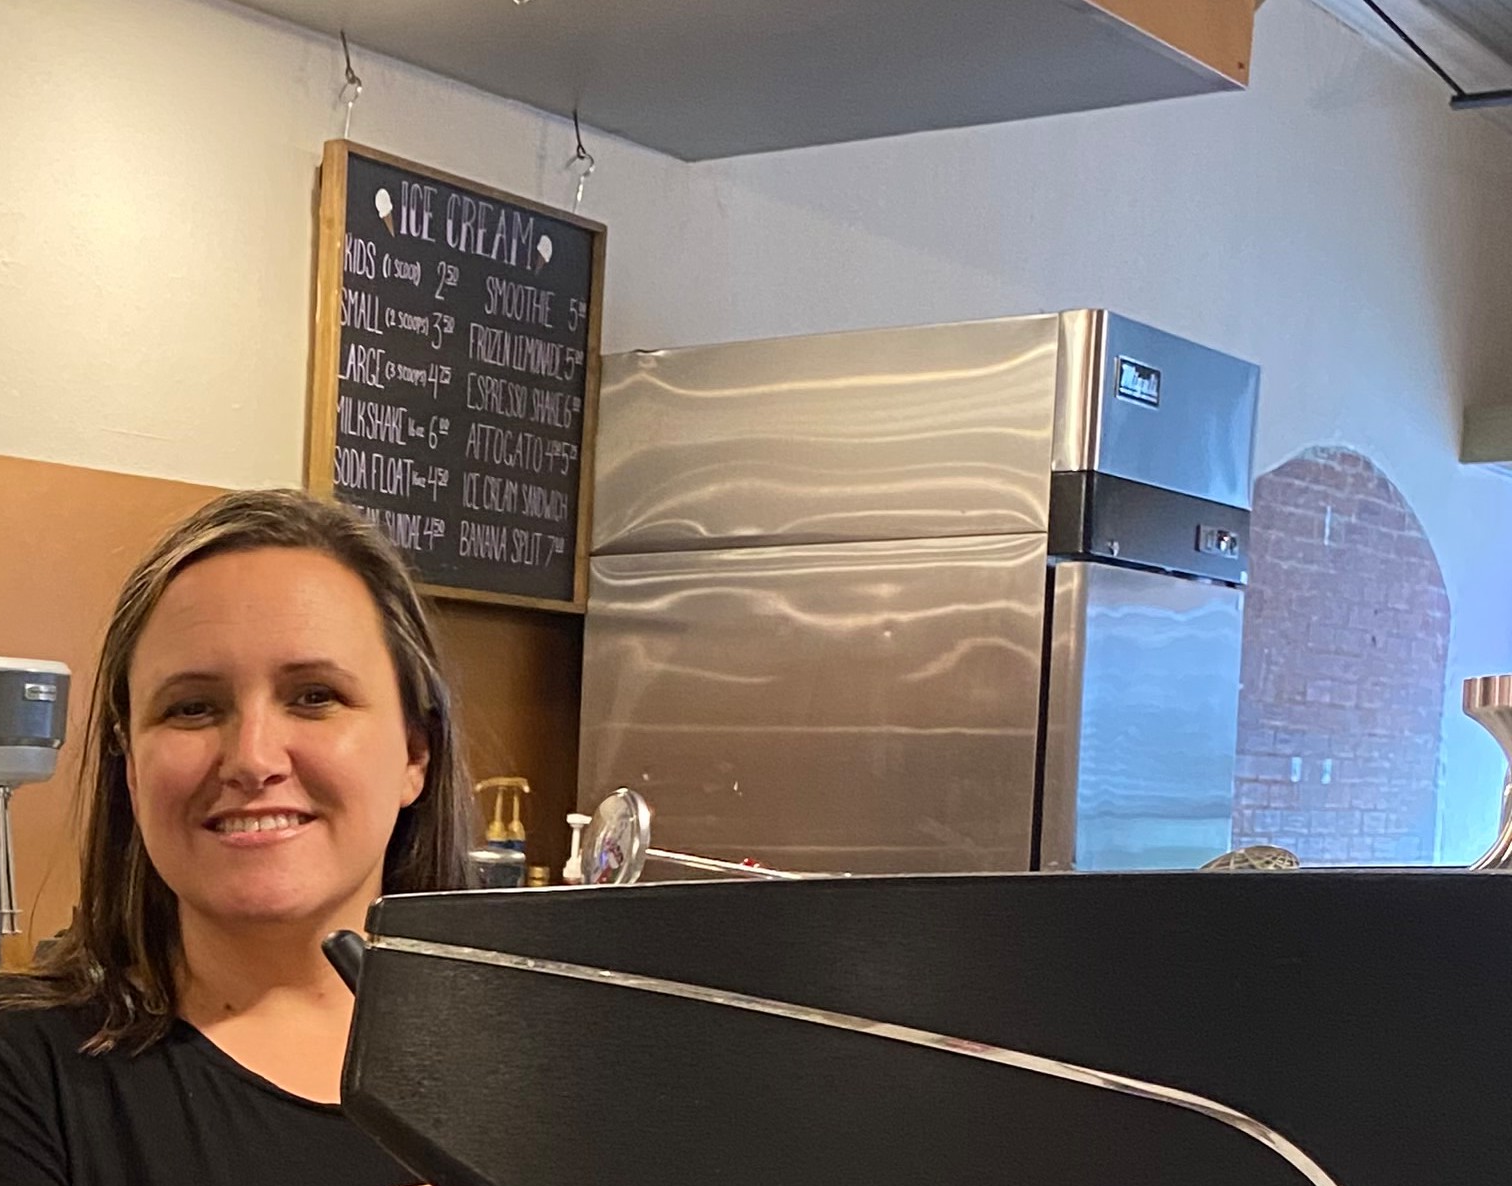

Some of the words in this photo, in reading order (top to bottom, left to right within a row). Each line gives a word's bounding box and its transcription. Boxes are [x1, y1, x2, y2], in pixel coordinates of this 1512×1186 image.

[399, 180, 438, 243] ICE
[446, 193, 535, 270] CREAM
[343, 231, 377, 280] KIDS
[340, 286, 384, 335] SMALL
[484, 275, 556, 329] SMOOTHIE
[467, 371, 528, 419] ESPRESSO
[337, 394, 408, 446] MILKSHAKE
[333, 445, 368, 490] SODA
[371, 452, 415, 498] FLOAT
[462, 471, 481, 510] ICE
[459, 519, 507, 562] BANANA
[510, 527, 543, 567] SPLIT
